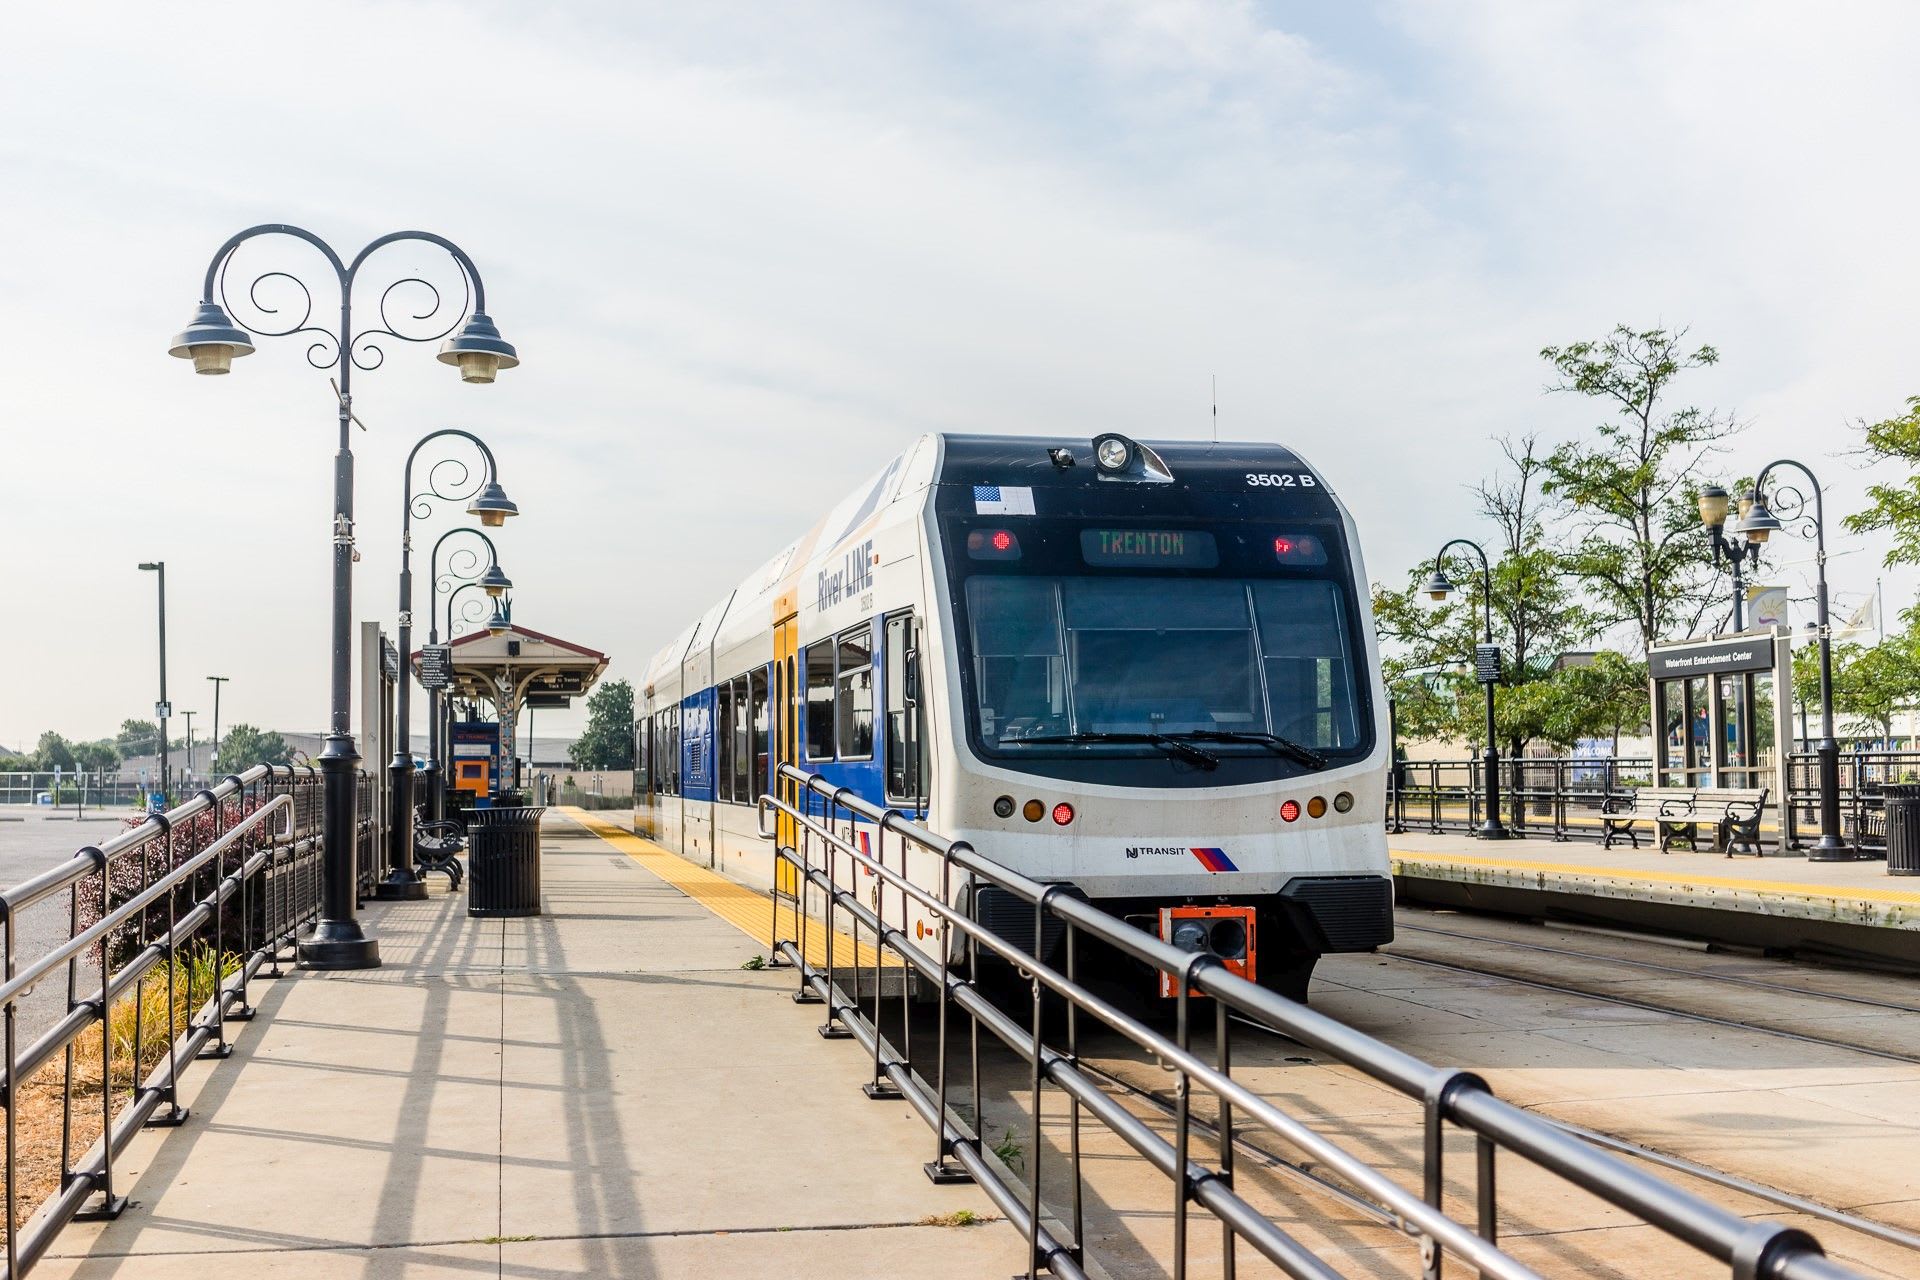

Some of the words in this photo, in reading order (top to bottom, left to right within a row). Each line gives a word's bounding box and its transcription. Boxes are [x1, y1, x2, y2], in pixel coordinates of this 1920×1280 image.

[1245, 473, 1296, 487] 3502
[1298, 474, 1316, 487] B
[1099, 530, 1185, 555] TRENTON
[818, 568, 843, 613] River
[846, 539, 873, 598] LINE
[1665, 657, 1693, 668] Waterfront
[1693, 653, 1732, 666] Entertainment
[1732, 651, 1753, 663] Center
[1125, 847, 1139, 859] NJ
[1139, 847, 1186, 856] TRANSIT
